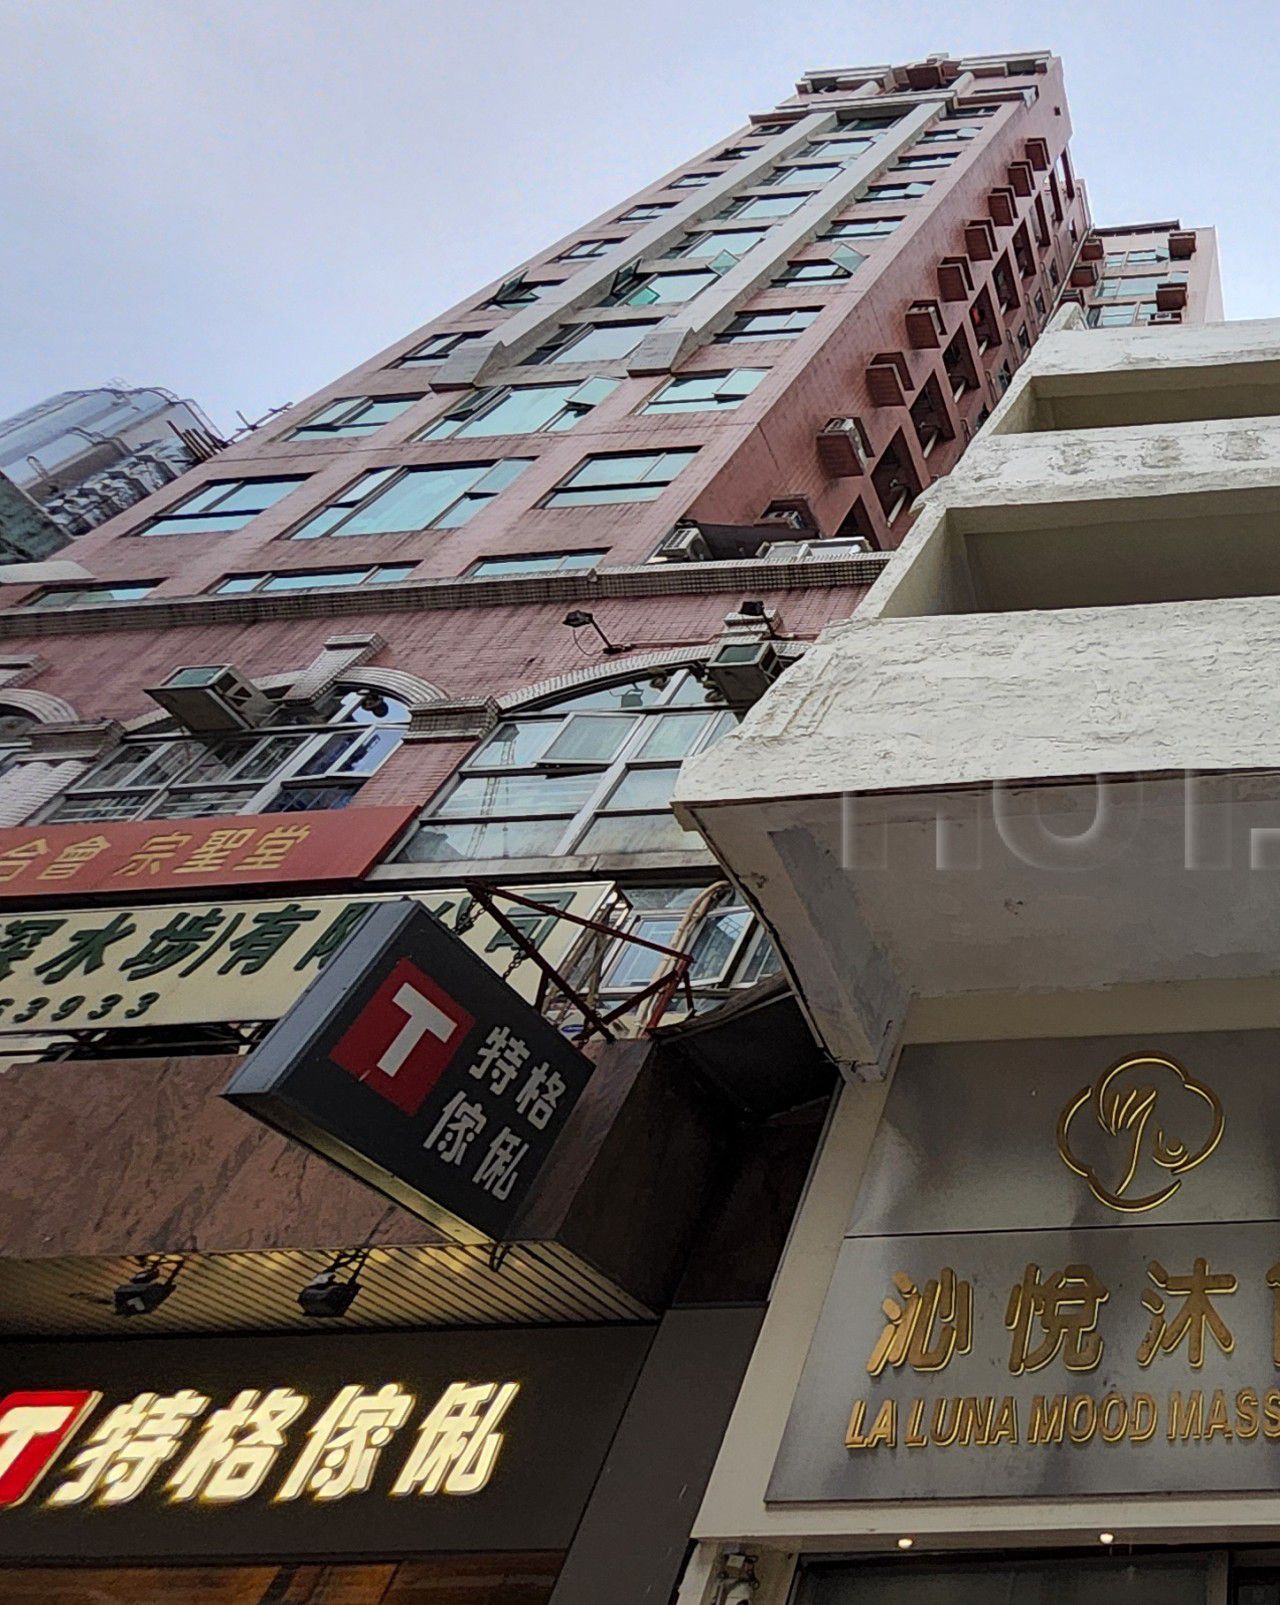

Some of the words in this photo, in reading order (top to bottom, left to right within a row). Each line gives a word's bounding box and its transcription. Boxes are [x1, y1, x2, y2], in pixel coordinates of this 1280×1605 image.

[113, 822, 312, 877] 宗聖堂
[382, 982, 458, 1078] T
[468, 1026, 568, 1131] 特格
[422, 1090, 530, 1201] 傢俬
[48, 1381, 519, 1506] 特格傢俬
[844, 1400, 896, 1449] LA
[904, 1396, 1018, 1447] LUNA
[1027, 1391, 1157, 1445] MOOD
